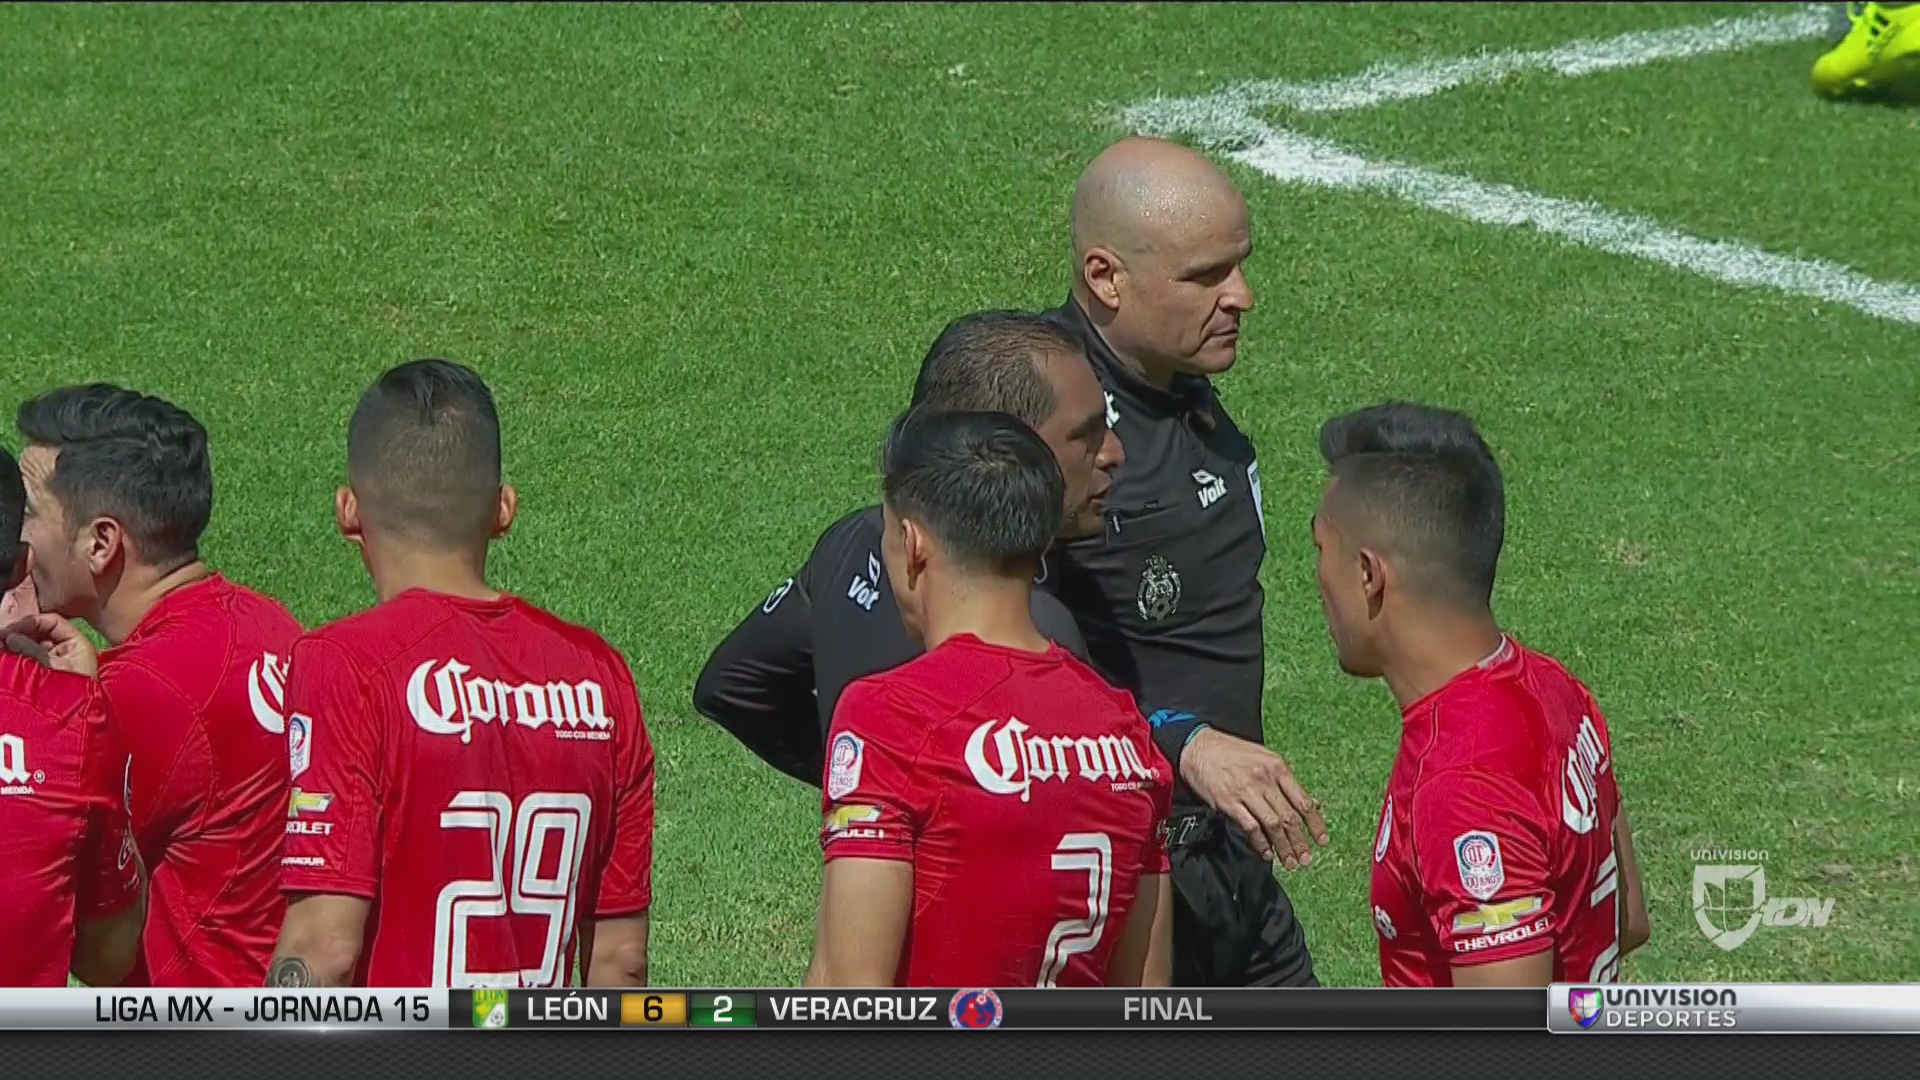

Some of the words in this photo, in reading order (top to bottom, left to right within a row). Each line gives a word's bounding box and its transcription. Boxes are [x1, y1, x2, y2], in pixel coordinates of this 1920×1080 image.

[406, 658, 612, 744] Corona
[431, 790, 593, 988] 29
[1454, 917, 1550, 953] CHEVROLET
